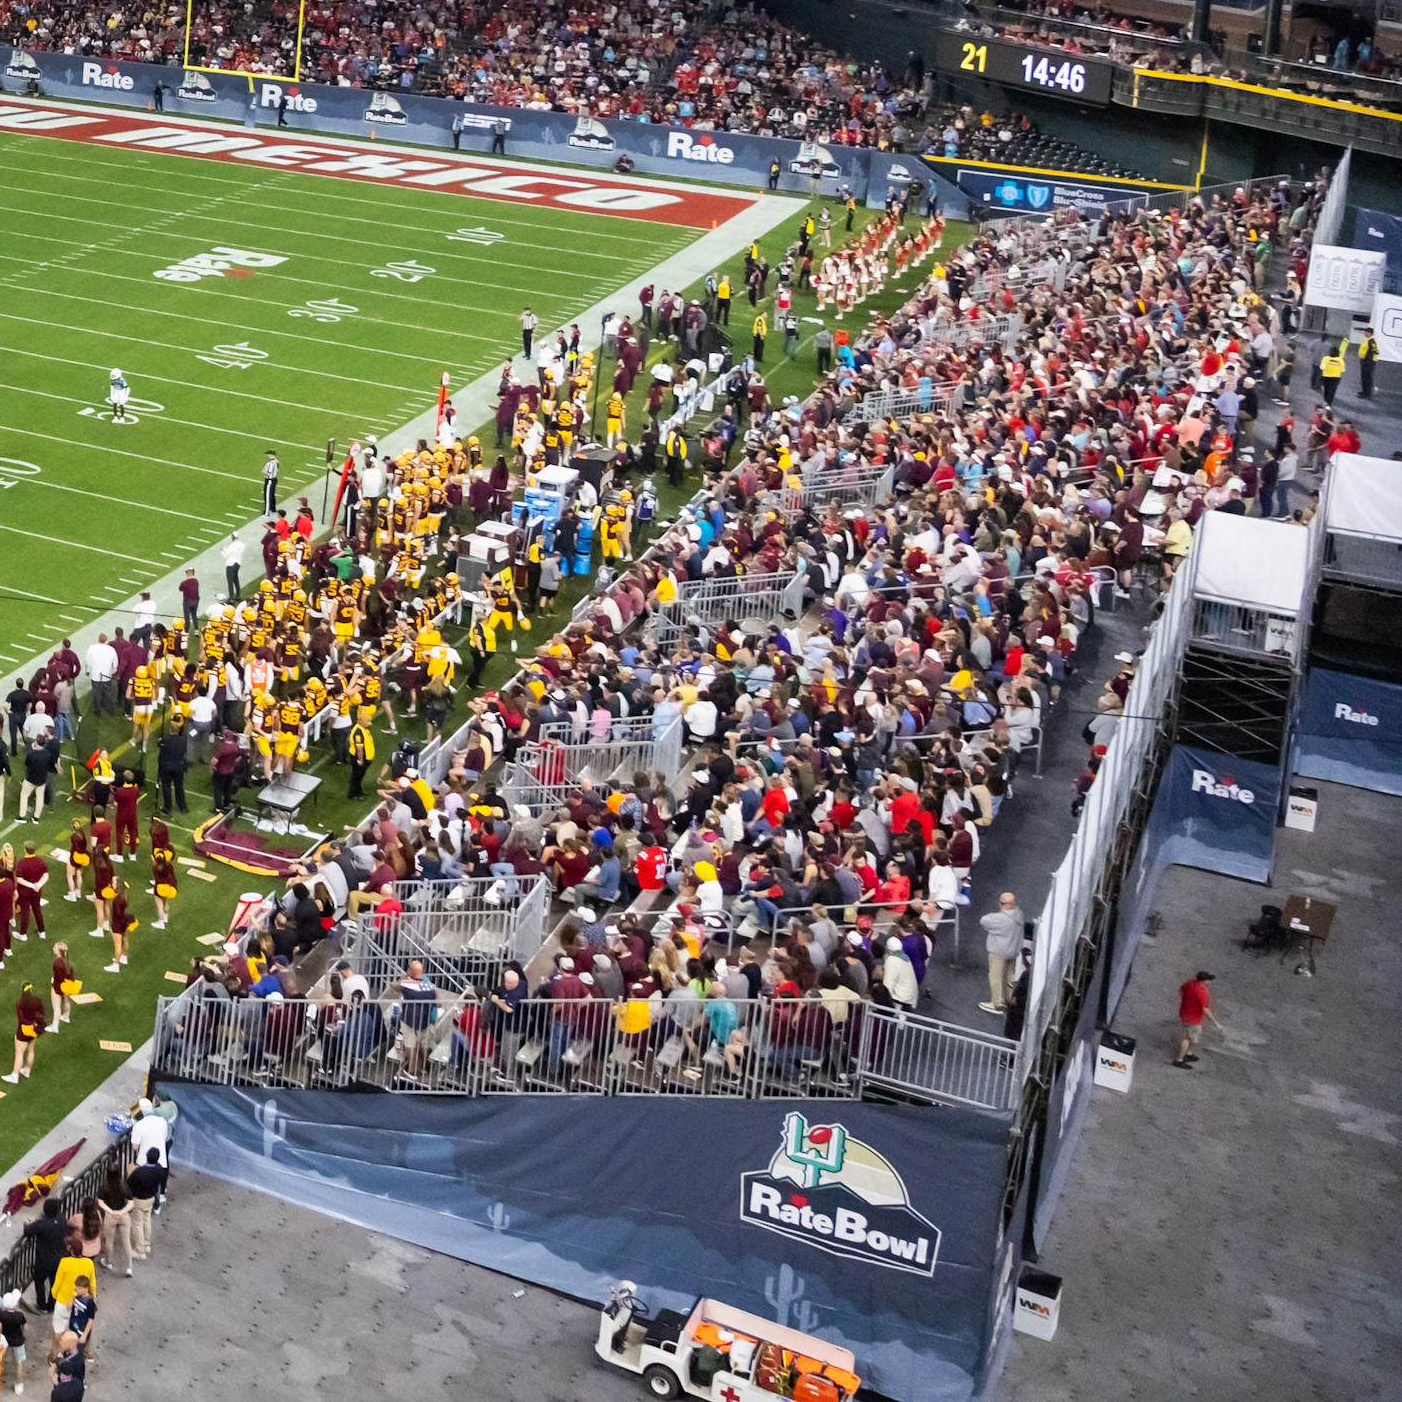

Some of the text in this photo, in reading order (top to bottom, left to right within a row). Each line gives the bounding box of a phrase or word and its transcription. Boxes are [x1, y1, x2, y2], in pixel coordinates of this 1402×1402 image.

[961, 41, 988, 73] 21
[82, 62, 134, 91] Rate
[1021, 54, 1086, 94] 14:46
[667, 131, 735, 165] Rate
[91, 126, 684, 211] MEXICO
[1053, 186, 1105, 201] BlueCross
[446, 227, 504, 246] 10
[153, 246, 289, 282] Rate
[370, 259, 436, 283] 20
[288, 298, 358, 322] 30
[197, 343, 269, 370] 40
[280, 708, 300, 727] 98
[1334, 702, 1380, 728] Rate
[1192, 769, 1256, 805] Rate
[1100, 1056, 1128, 1071] WM
[1019, 1297, 1051, 1317] WM
